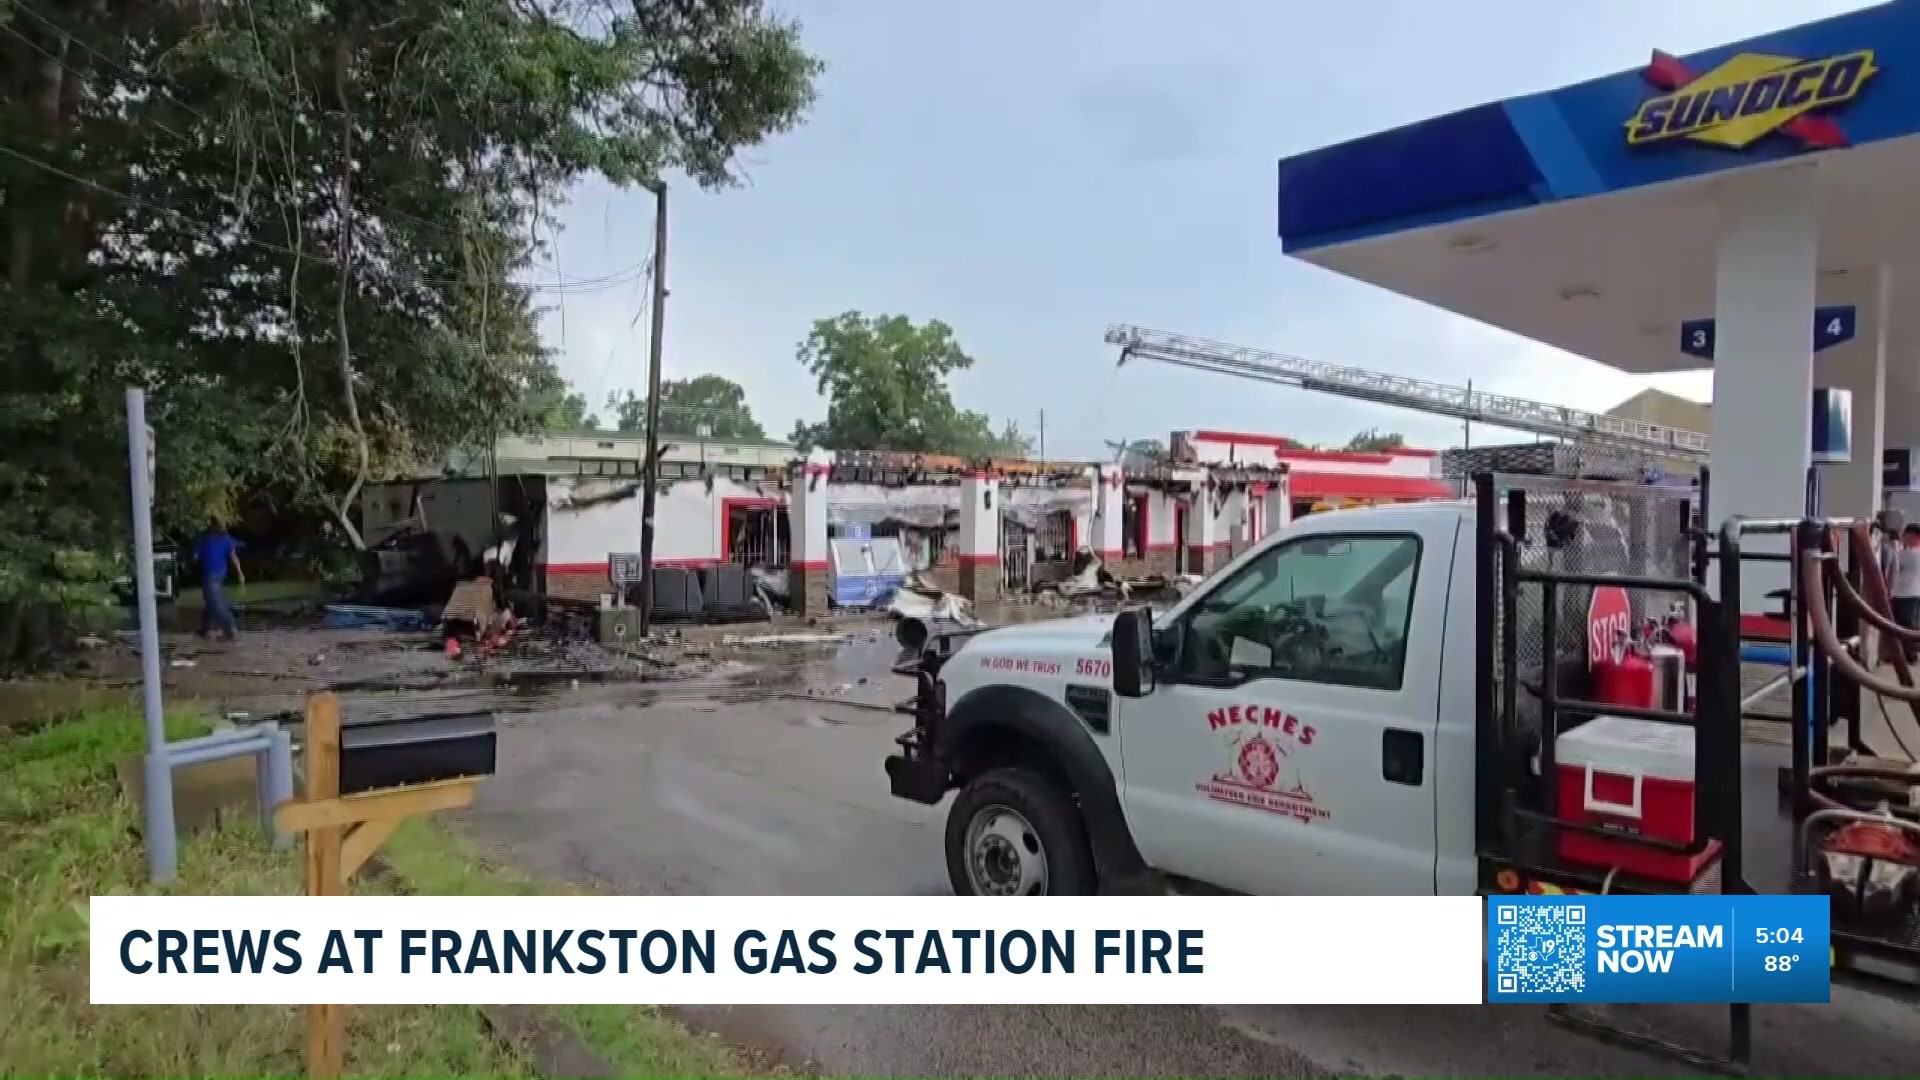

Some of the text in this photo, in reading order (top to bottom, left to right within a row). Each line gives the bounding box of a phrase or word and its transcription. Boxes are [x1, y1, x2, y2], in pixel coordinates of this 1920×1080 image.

[1634, 54, 1868, 139] SUNOCO
[1826, 317, 1843, 336] 4
[1692, 330, 1706, 348] 3
[1592, 611, 1627, 662] STOP
[980, 656, 1062, 676] IN GOD WE TRUST
[1075, 658, 1111, 678] 5670
[1207, 703, 1317, 746] NECHES
